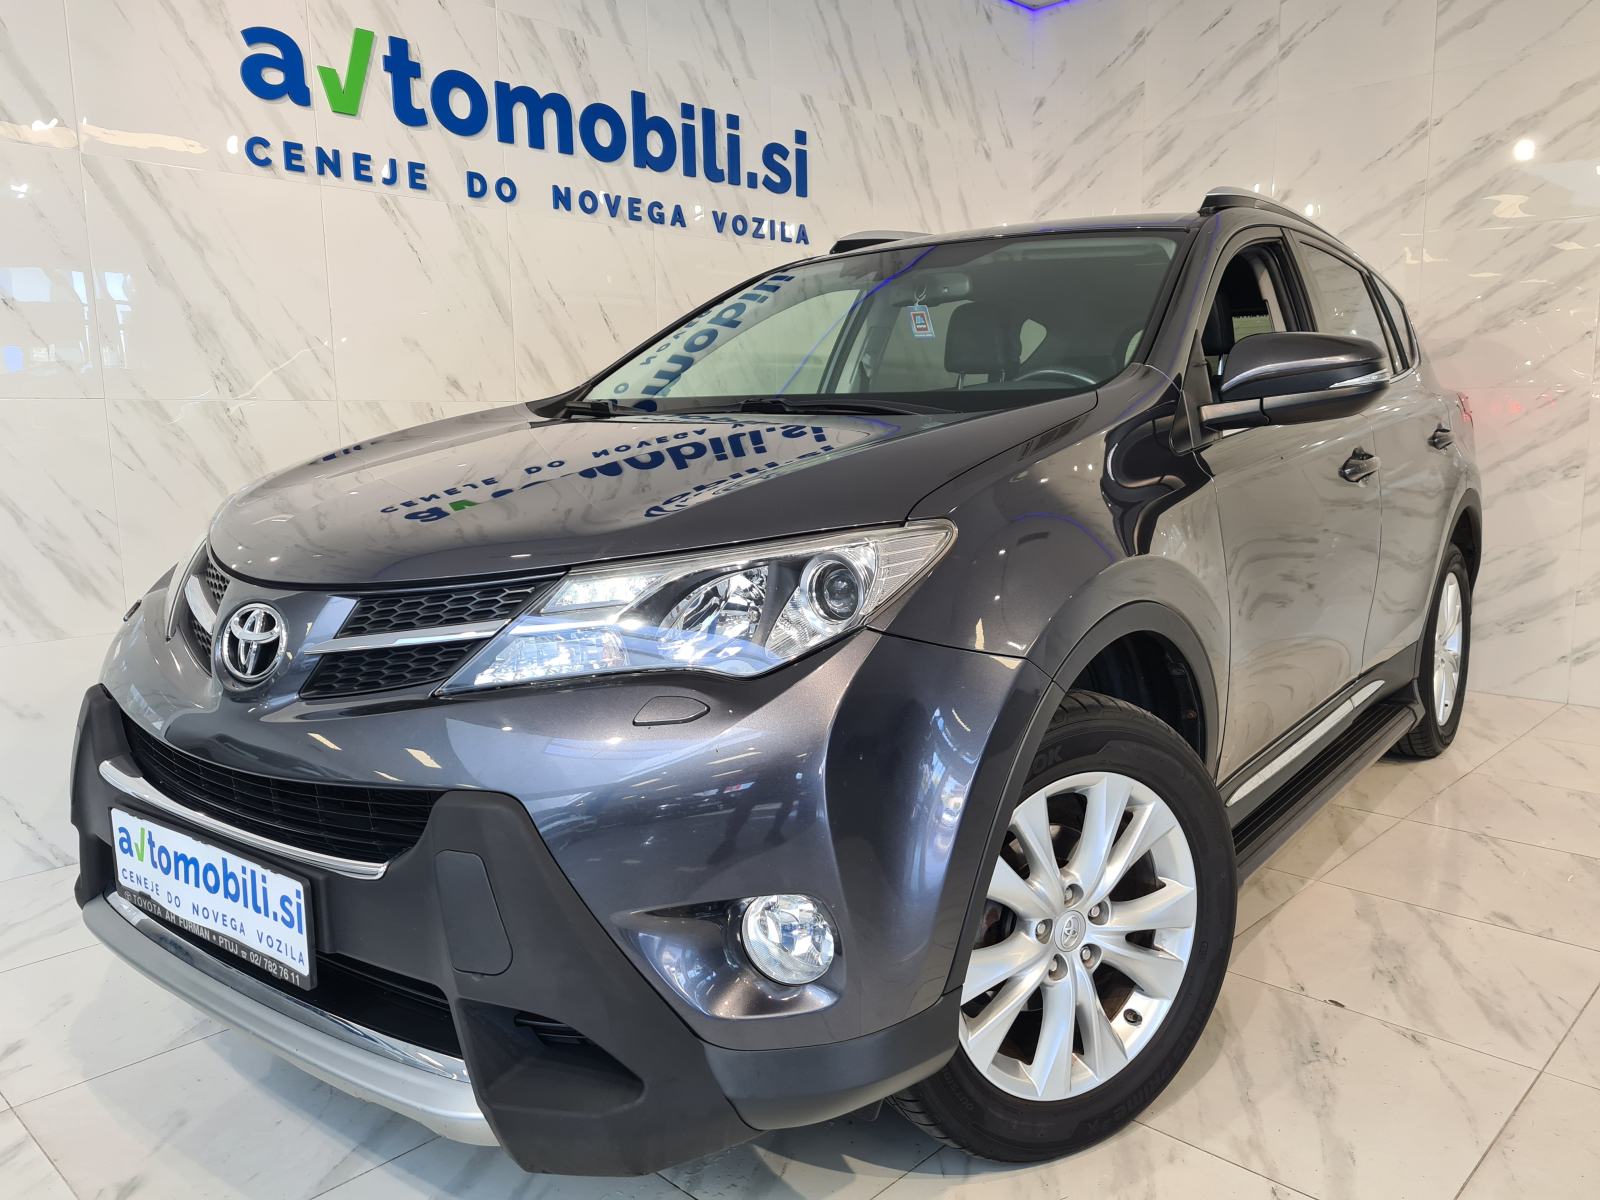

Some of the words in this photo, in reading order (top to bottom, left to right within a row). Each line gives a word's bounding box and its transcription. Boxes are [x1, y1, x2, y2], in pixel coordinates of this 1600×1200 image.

[245, 136, 427, 190] CENEJE
[466, 171, 517, 203] DO
[552, 185, 686, 228] NOVEGA
[712, 211, 809, 245] VOZILA
[121, 868, 160, 896] CENEJE
[167, 891, 181, 908] DO
[192, 902, 246, 937] NOVEGA
[256, 929, 305, 967] VOZILA
[132, 893, 162, 916] TOYOTA
[178, 918, 210, 941] FURMAN
[218, 935, 238, 955] PTUJ
[278, 965, 289, 980] 76
[290, 971, 300, 987] 11
